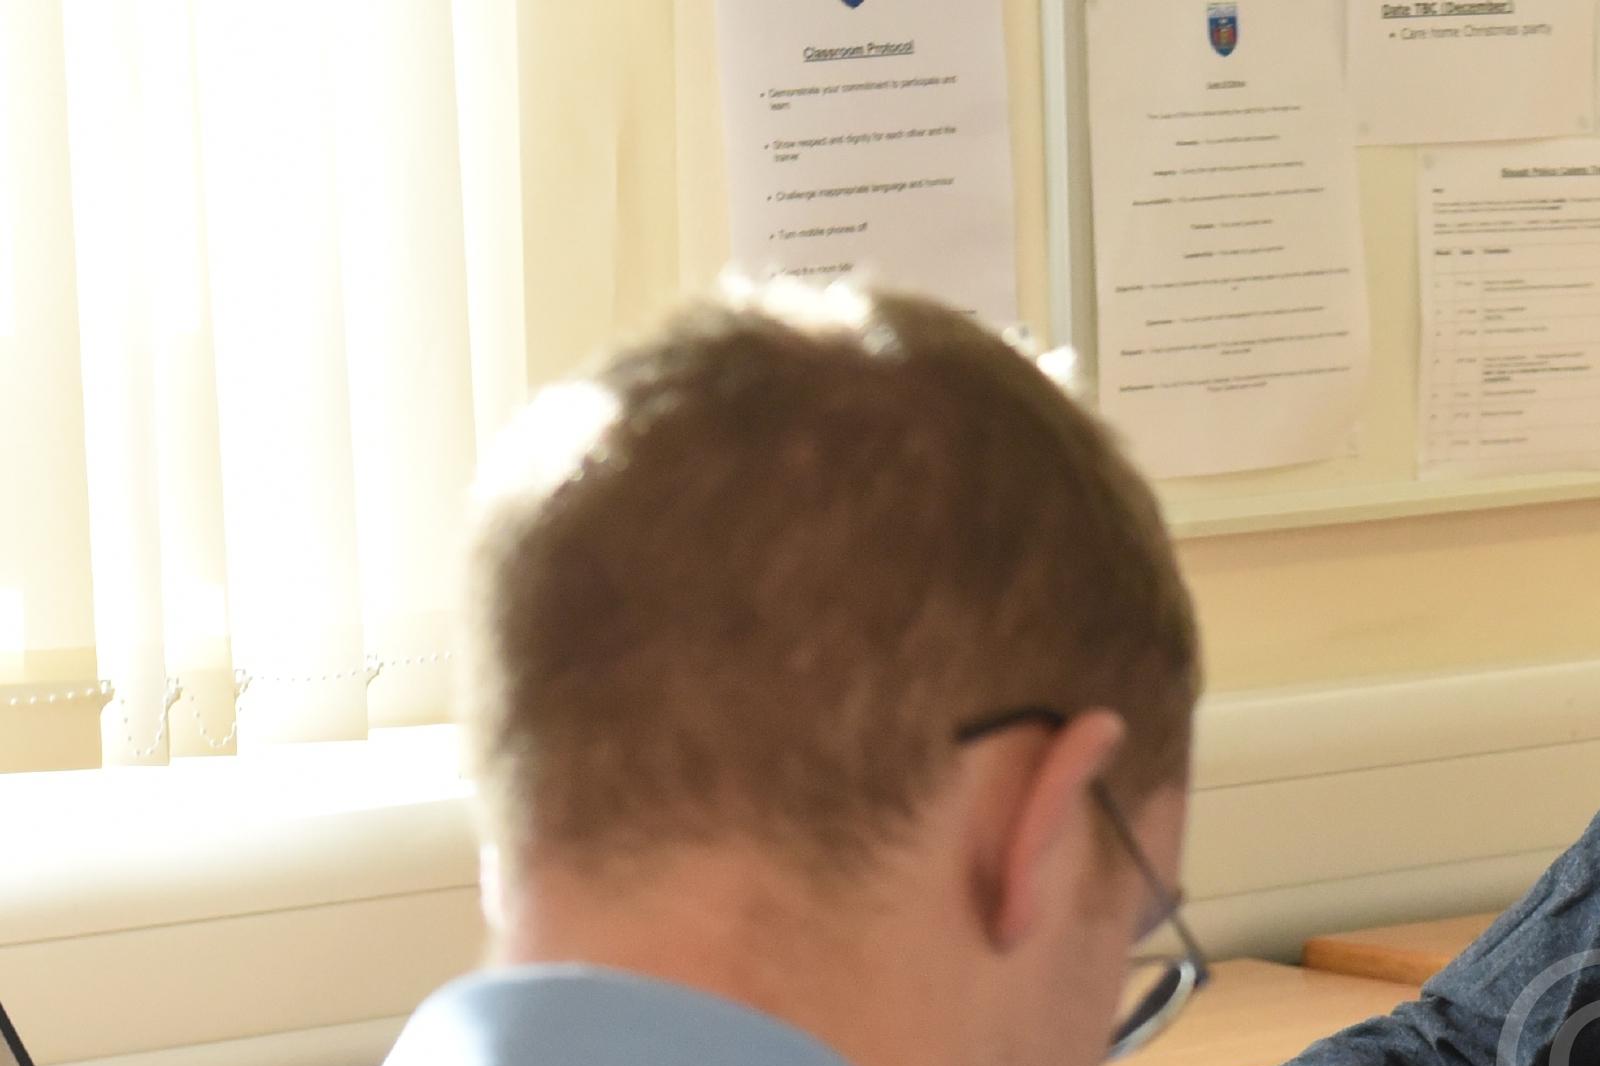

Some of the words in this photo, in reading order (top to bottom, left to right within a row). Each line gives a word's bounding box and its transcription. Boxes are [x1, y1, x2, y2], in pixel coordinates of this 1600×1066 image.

[1400, 28, 1426, 40] Care
[1464, 24, 1518, 37] Christmas
[803, 44, 864, 62] Classroom
[867, 40, 915, 57] Protocol
